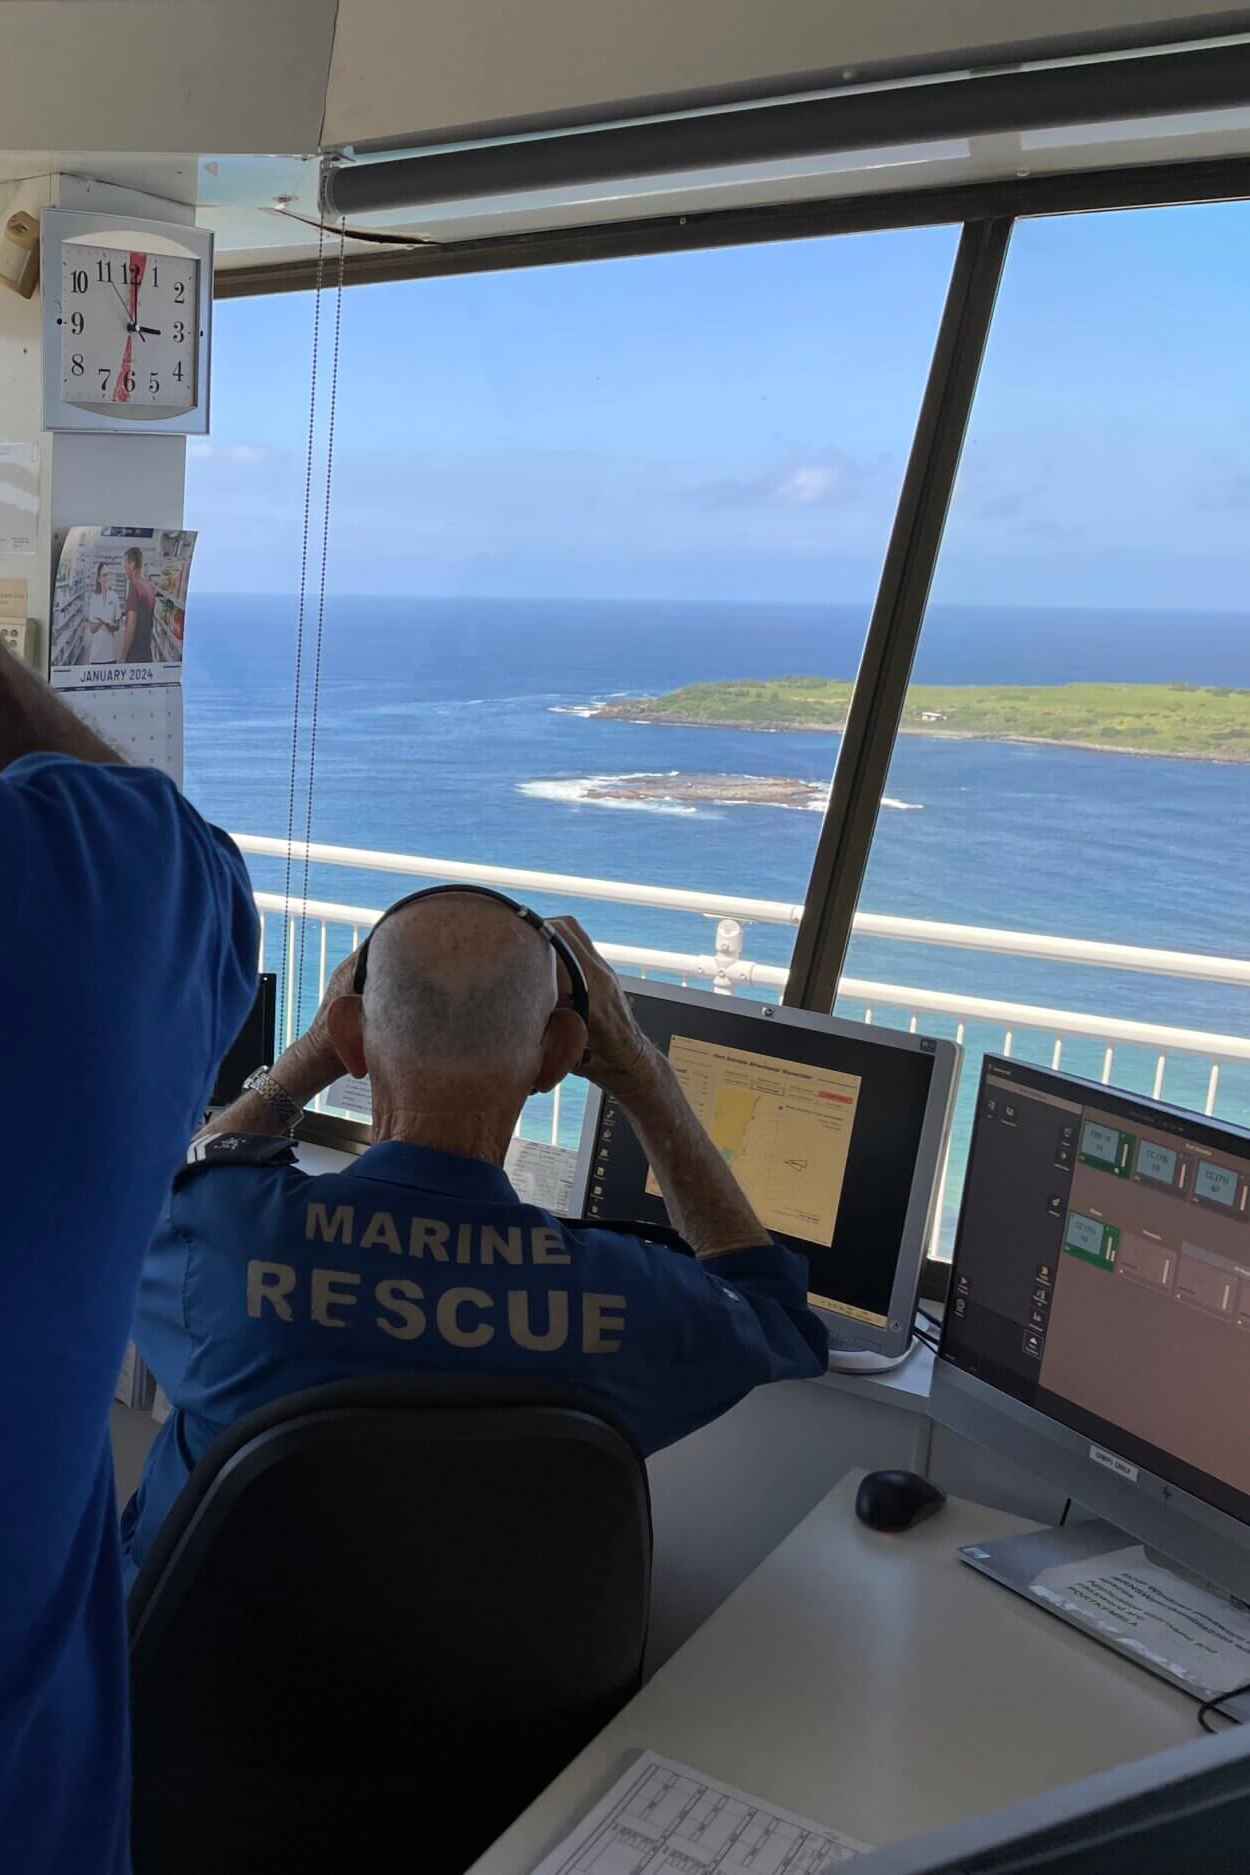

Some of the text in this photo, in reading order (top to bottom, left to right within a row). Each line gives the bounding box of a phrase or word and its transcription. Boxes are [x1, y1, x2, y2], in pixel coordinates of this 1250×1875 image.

[70, 270, 88, 294] 10
[96, 259, 112, 283] 11
[121, 262, 142, 285] 12
[153, 266, 159, 287] 1
[174, 282, 185, 304] 2
[71, 312, 84, 335] 9
[173, 321, 184, 343] 3
[71, 354, 84, 376] 8
[172, 361, 183, 382] 4
[98, 369, 111, 391] 7
[123, 370, 135, 392] 6
[149, 373, 160, 393] 5
[80, 668, 153, 682] JANUARY 2024
[305, 1203, 572, 1265] MARINE
[247, 1260, 627, 1354] RESCUE
